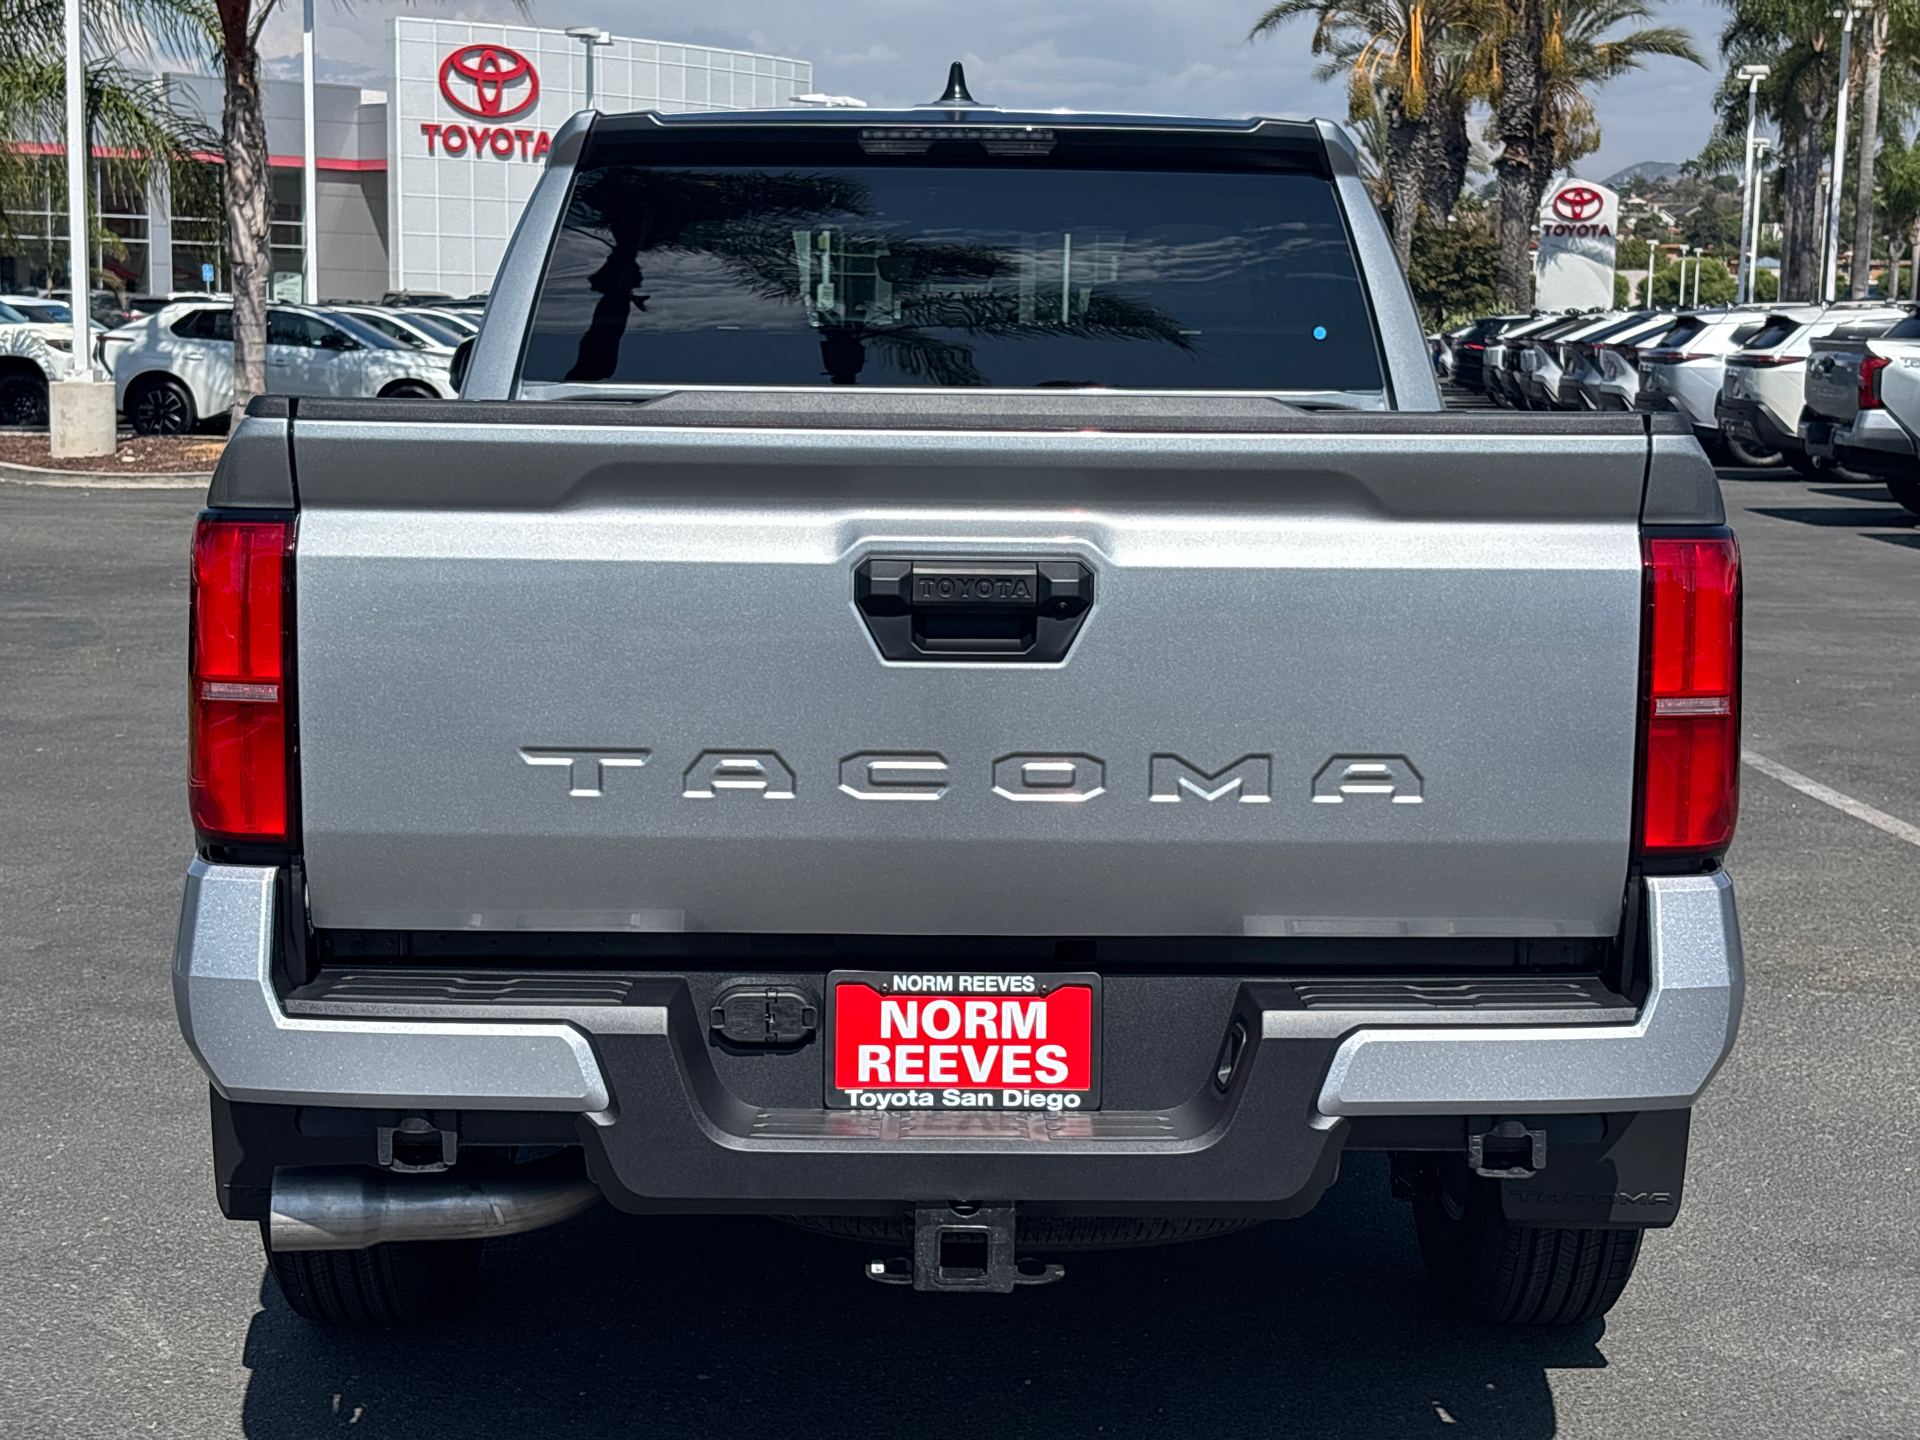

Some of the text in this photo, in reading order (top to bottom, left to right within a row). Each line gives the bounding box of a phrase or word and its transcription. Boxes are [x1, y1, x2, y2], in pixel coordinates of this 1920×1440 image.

[421, 124, 551, 157] TOYOTA
[1543, 224, 1610, 237] TOYOTA
[918, 577, 1031, 599] TOYOTA
[518, 747, 1424, 802] TACOMA
[893, 975, 1034, 992] NORM REEVES
[880, 1000, 1047, 1039] NORM
[858, 1045, 1068, 1083] REEVES
[845, 1089, 1081, 1111] Toyota San Diego
